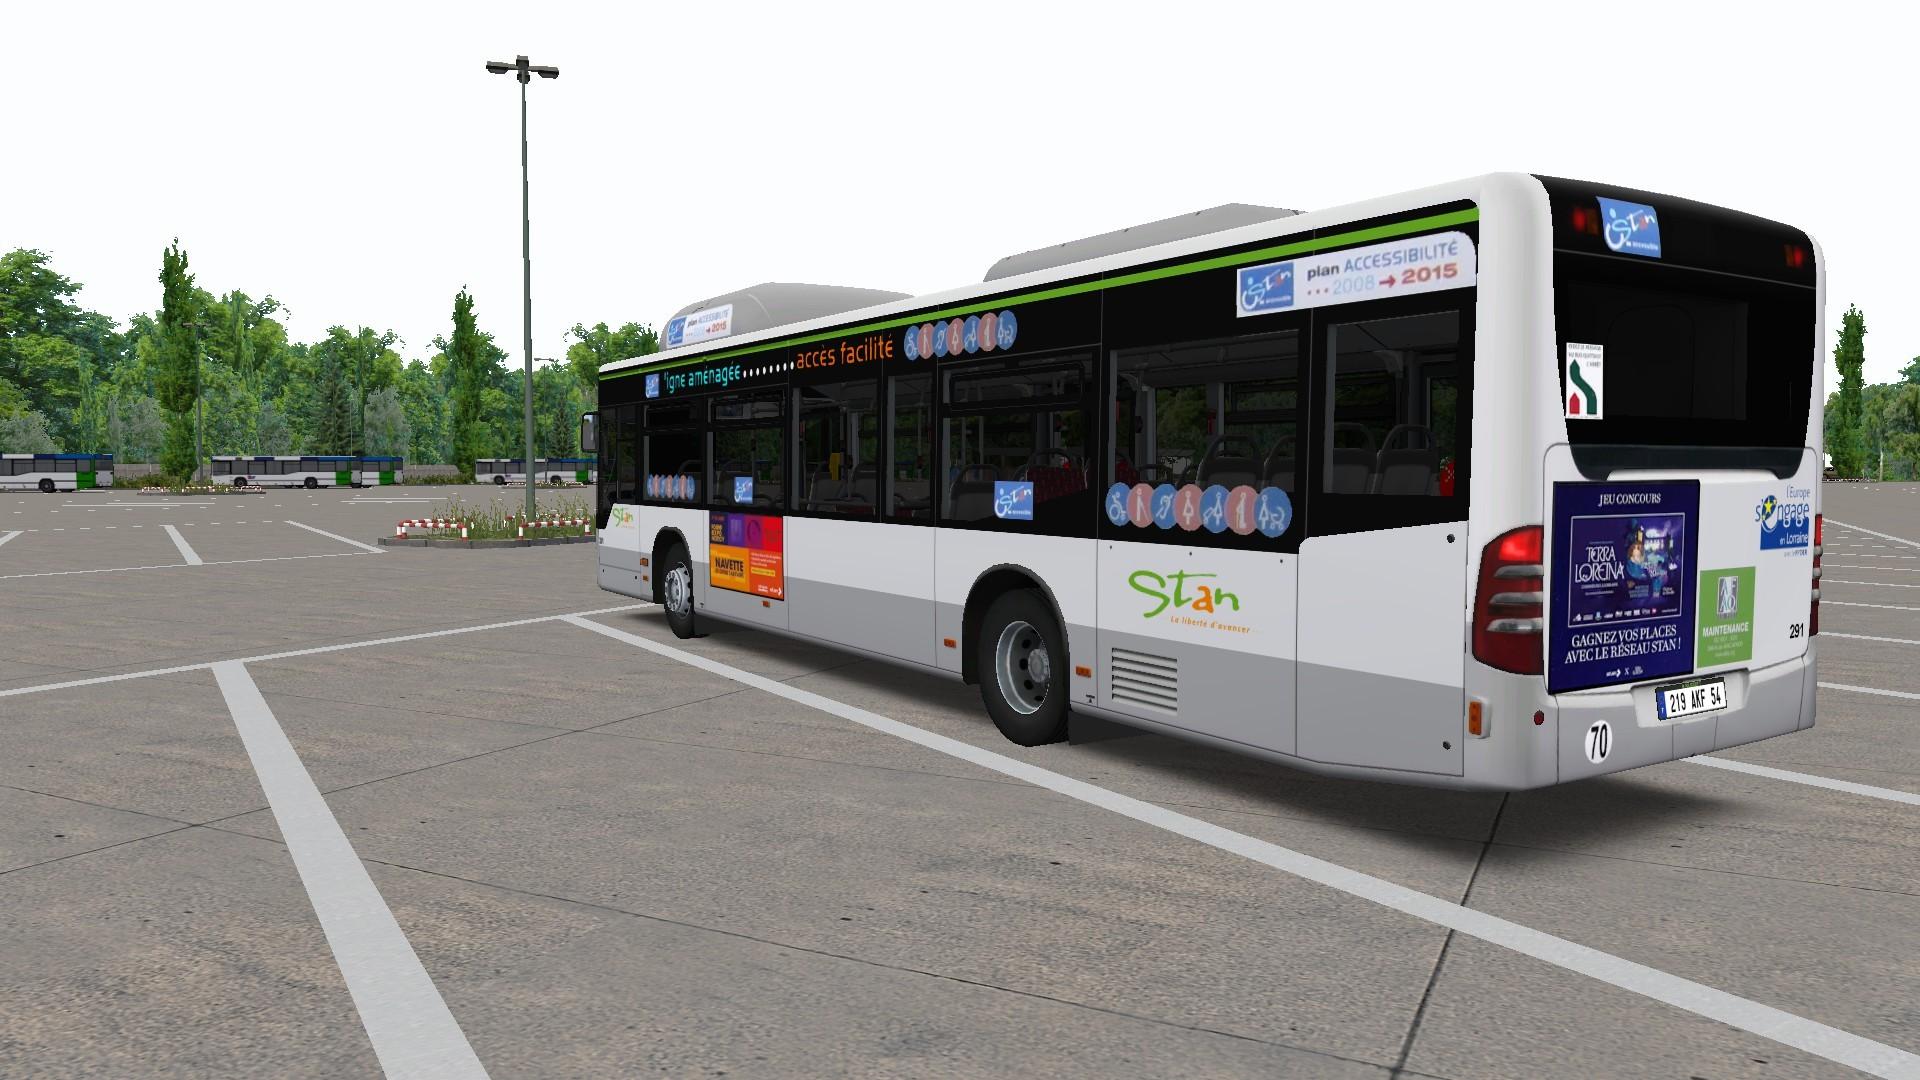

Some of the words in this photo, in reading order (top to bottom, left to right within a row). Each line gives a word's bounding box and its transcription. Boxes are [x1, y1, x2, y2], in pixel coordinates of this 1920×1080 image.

[1307, 264, 1340, 281] plan
[1344, 238, 1459, 273] ACCESSIBILITÉ
[1332, 274, 1375, 295] 2008
[1401, 262, 1459, 285] 2015
[688, 360, 741, 387] aménagée
[796, 343, 836, 369] accès
[840, 333, 894, 365] facilité
[1597, 493, 1616, 507] JEU
[1616, 492, 1662, 505] CONCOURS
[1786, 531, 1809, 545] Lorraine
[715, 556, 744, 572] NAVETTE
[1128, 569, 1240, 618] Stan
[1170, 616, 1179, 624] La
[1181, 616, 1208, 628] liberté
[1210, 620, 1251, 634] d'avancer
[1571, 631, 1617, 648] GAGNEZ
[1618, 629, 1639, 642] VOS
[1640, 624, 1677, 640] PLACES
[1703, 622, 1749, 638] MAINTENANCE
[1789, 622, 1804, 639] 291
[1564, 648, 1594, 664] AVEC
[1595, 646, 1608, 660] LE
[1610, 641, 1650, 658] RÉSEAU
[1651, 638, 1676, 653] STAN
[1670, 692, 1687, 713] 219
[1691, 689, 1705, 709] AKF
[1710, 686, 1722, 705] 54
[1591, 723, 1608, 760] 70
